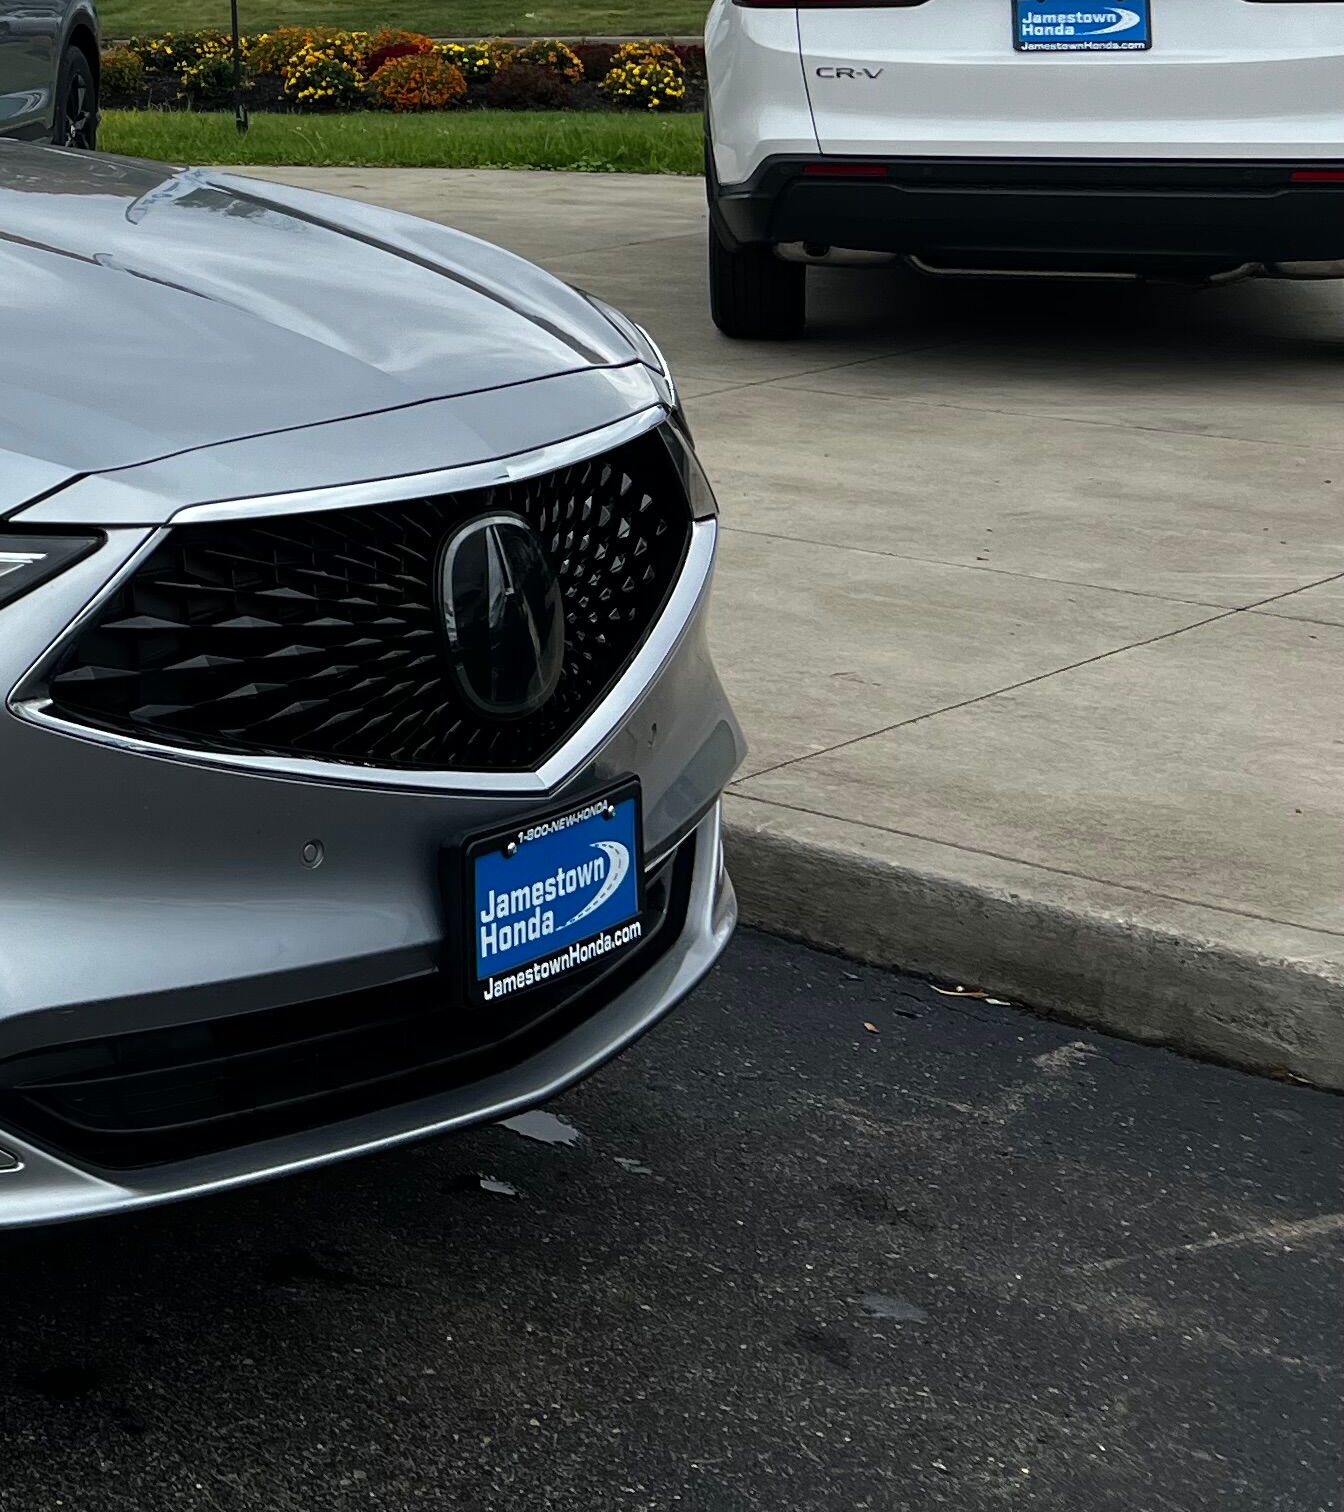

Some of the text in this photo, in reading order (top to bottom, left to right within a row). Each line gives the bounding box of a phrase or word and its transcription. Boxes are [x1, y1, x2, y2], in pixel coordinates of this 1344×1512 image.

[1021, 12, 1117, 24] Jamestown
[1021, 23, 1075, 36] Honda
[1020, 41, 1146, 51] JamestownHonda.com
[815, 66, 884, 79] CR-V
[517, 799, 608, 843] 1-800-NEW-HONDA
[480, 856, 605, 923] Jamestown
[480, 906, 555, 958] Honda
[483, 921, 642, 1001] JamestownHonda.com
